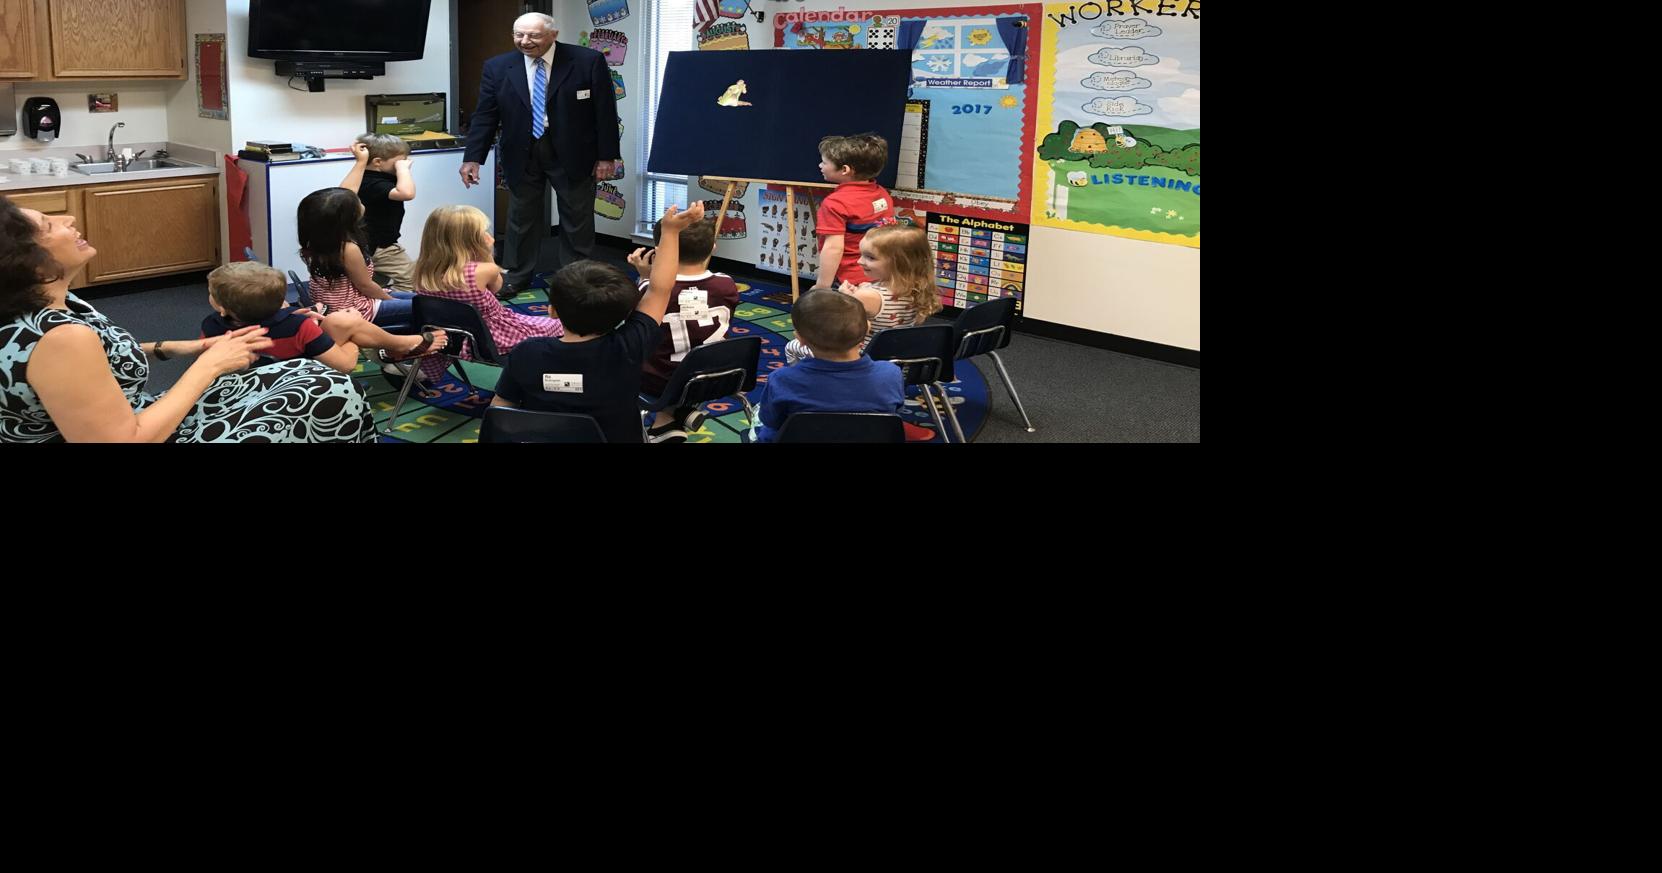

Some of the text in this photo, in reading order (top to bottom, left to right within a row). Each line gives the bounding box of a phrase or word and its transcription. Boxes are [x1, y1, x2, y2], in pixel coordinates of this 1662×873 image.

[928, 79, 992, 88] Weather Report
[952, 104, 993, 115] 2017
[939, 215, 1014, 231] The Alphabet
